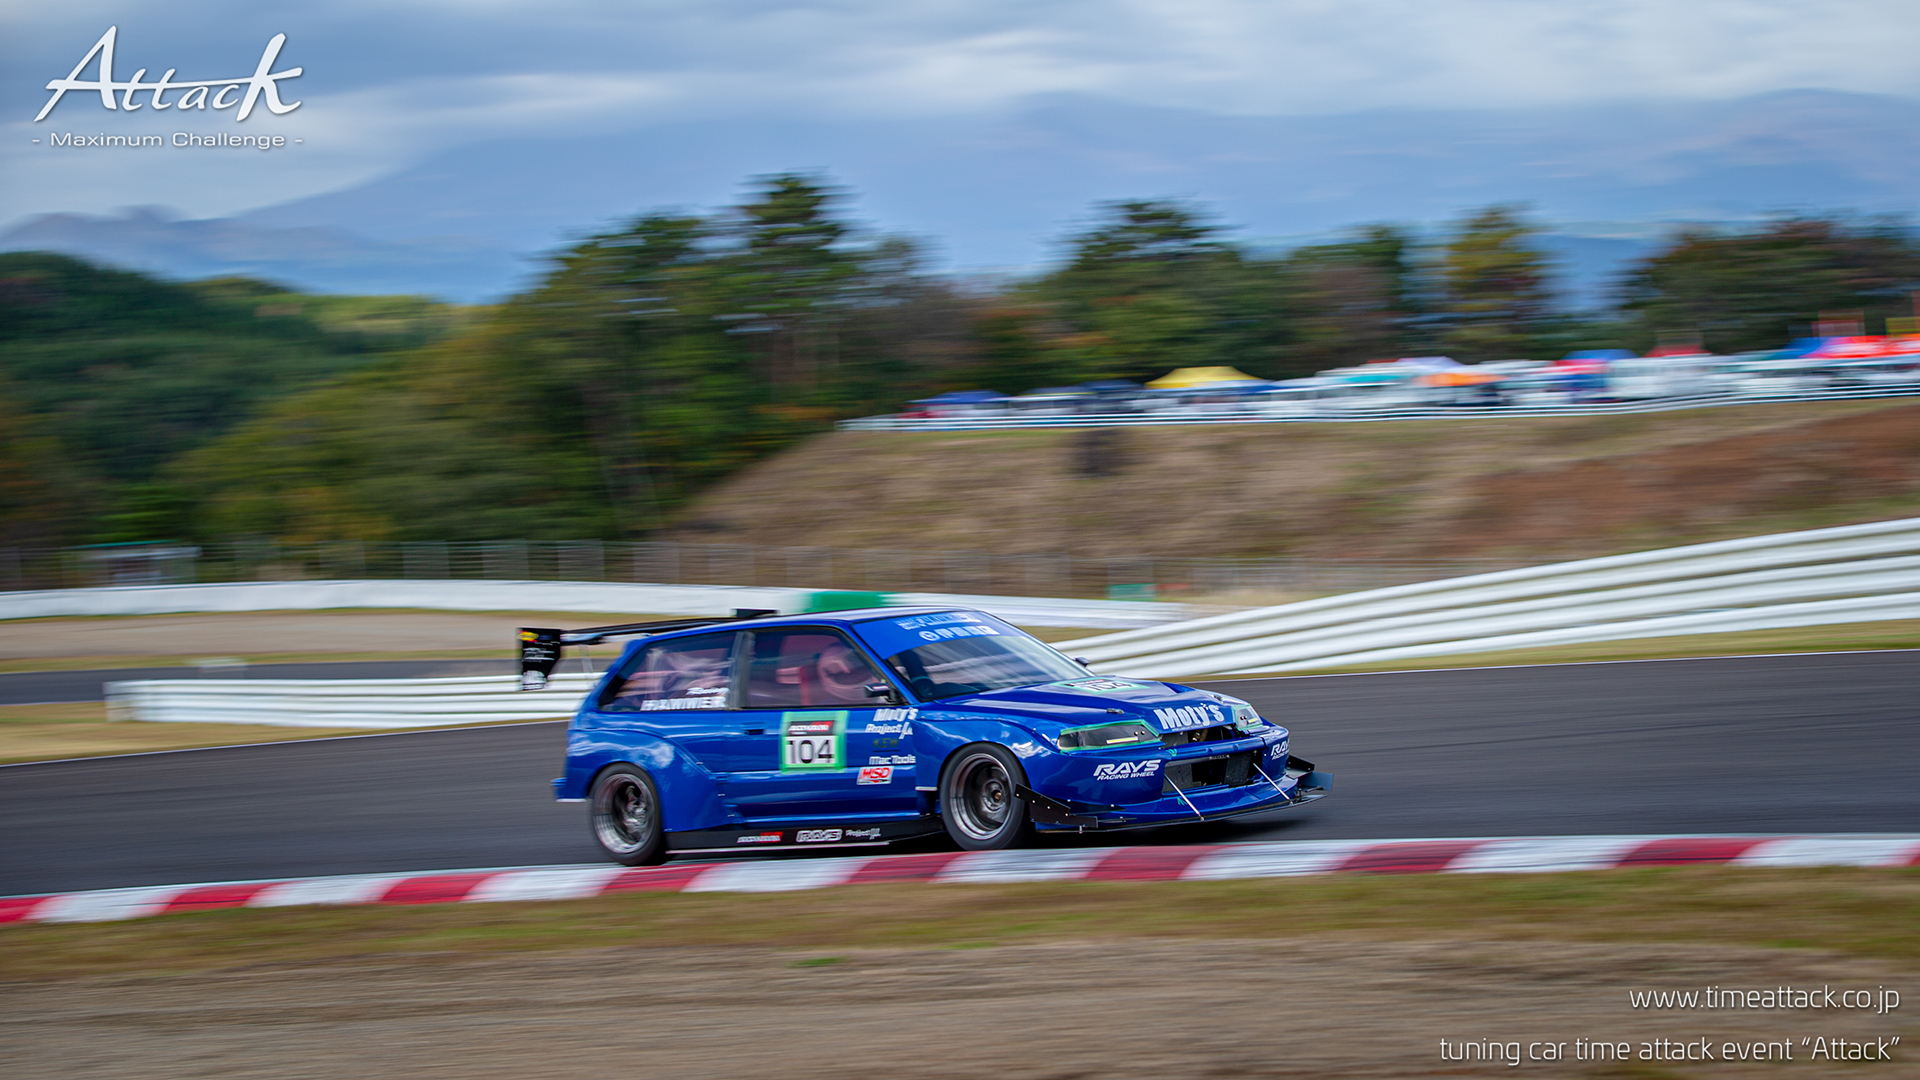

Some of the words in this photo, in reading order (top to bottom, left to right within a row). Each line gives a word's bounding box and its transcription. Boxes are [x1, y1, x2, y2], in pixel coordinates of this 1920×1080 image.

[1153, 702, 1225, 730] Moty's
[865, 723, 902, 735] Project
[786, 739, 835, 764] 104
[892, 754, 917, 765] Tools
[1093, 759, 1162, 777] RAYS
[1097, 773, 1130, 781] RACING
[1130, 771, 1155, 779] WHEEL
